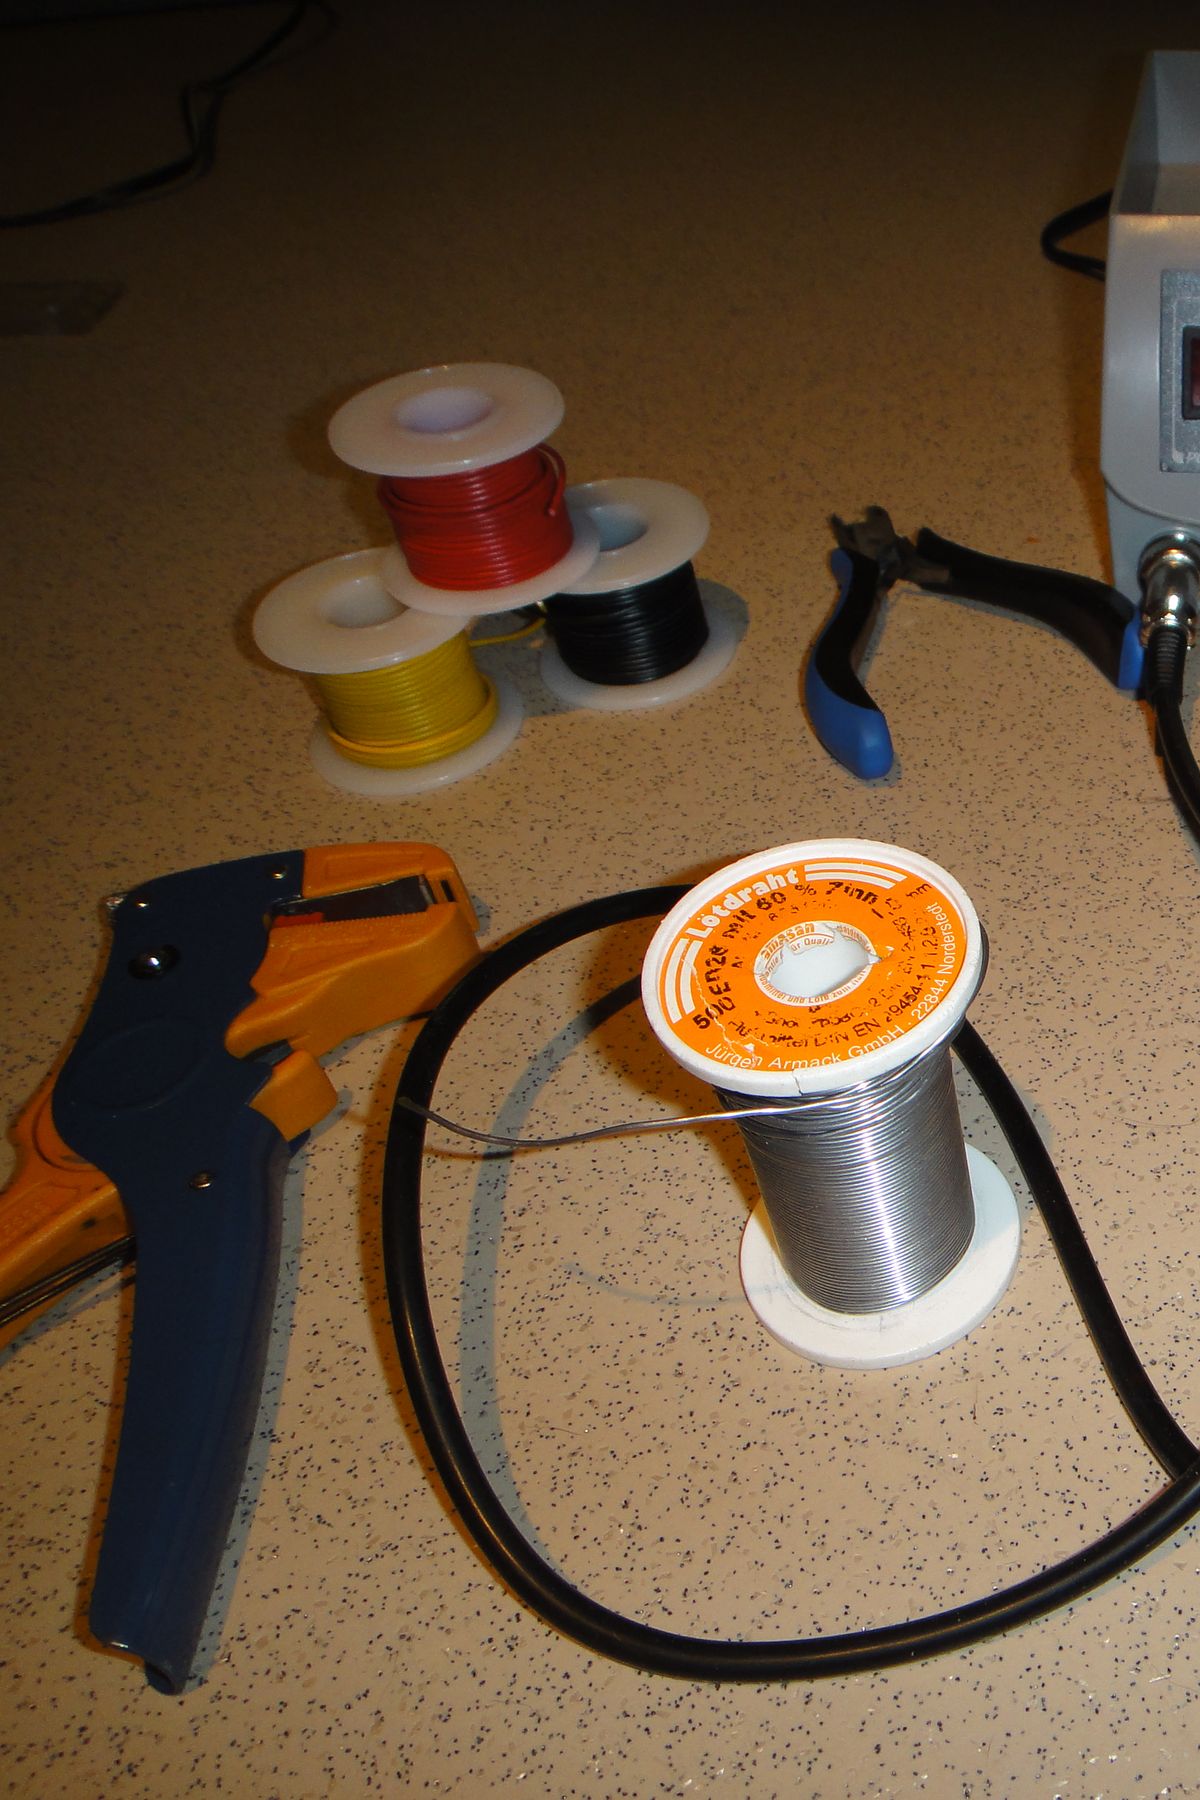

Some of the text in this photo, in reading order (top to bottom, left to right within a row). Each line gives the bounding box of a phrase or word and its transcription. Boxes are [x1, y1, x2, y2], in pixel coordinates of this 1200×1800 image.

[685, 868, 800, 939] Lötdraht
[925, 901, 956, 976] Norderstedt
[911, 978, 949, 1021] 22844
[705, 1043, 763, 1069] Jürgen
[768, 1052, 842, 1071] Armack
[848, 1025, 905, 1060] GmbH
